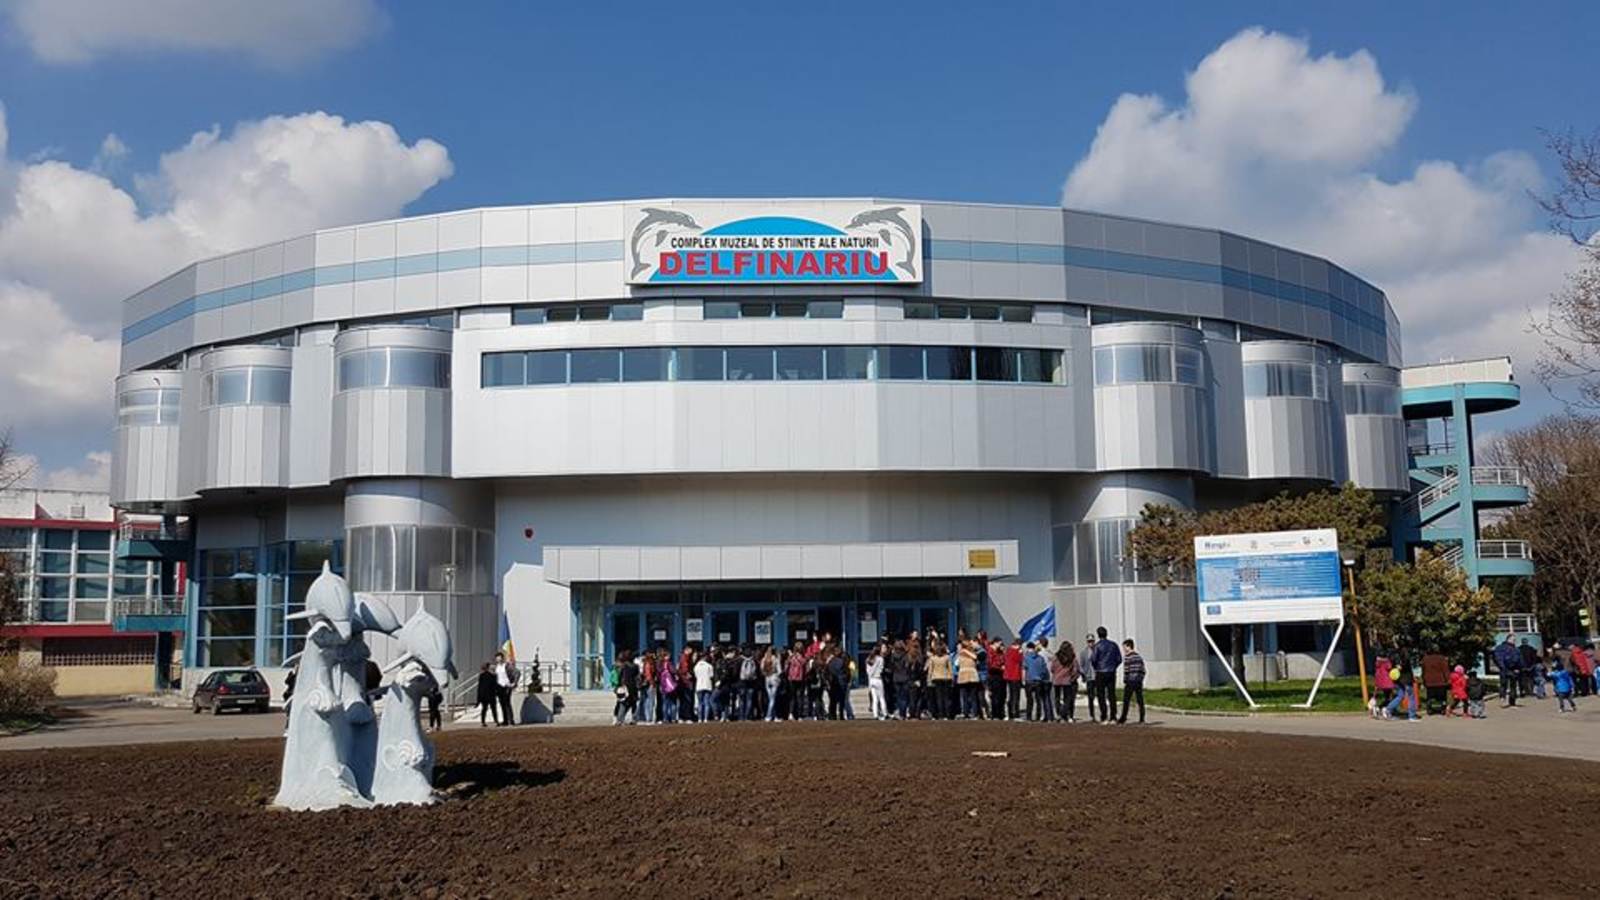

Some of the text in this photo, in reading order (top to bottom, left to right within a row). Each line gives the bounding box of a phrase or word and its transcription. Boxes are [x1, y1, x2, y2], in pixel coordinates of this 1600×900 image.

[671, 237, 717, 249] COMPLEX
[720, 237, 759, 249] MUZEAL
[762, 237, 774, 249] DE
[818, 237, 837, 248] ALE
[840, 237, 879, 248] NATURII
[659, 251, 888, 275] DELFINARIU
